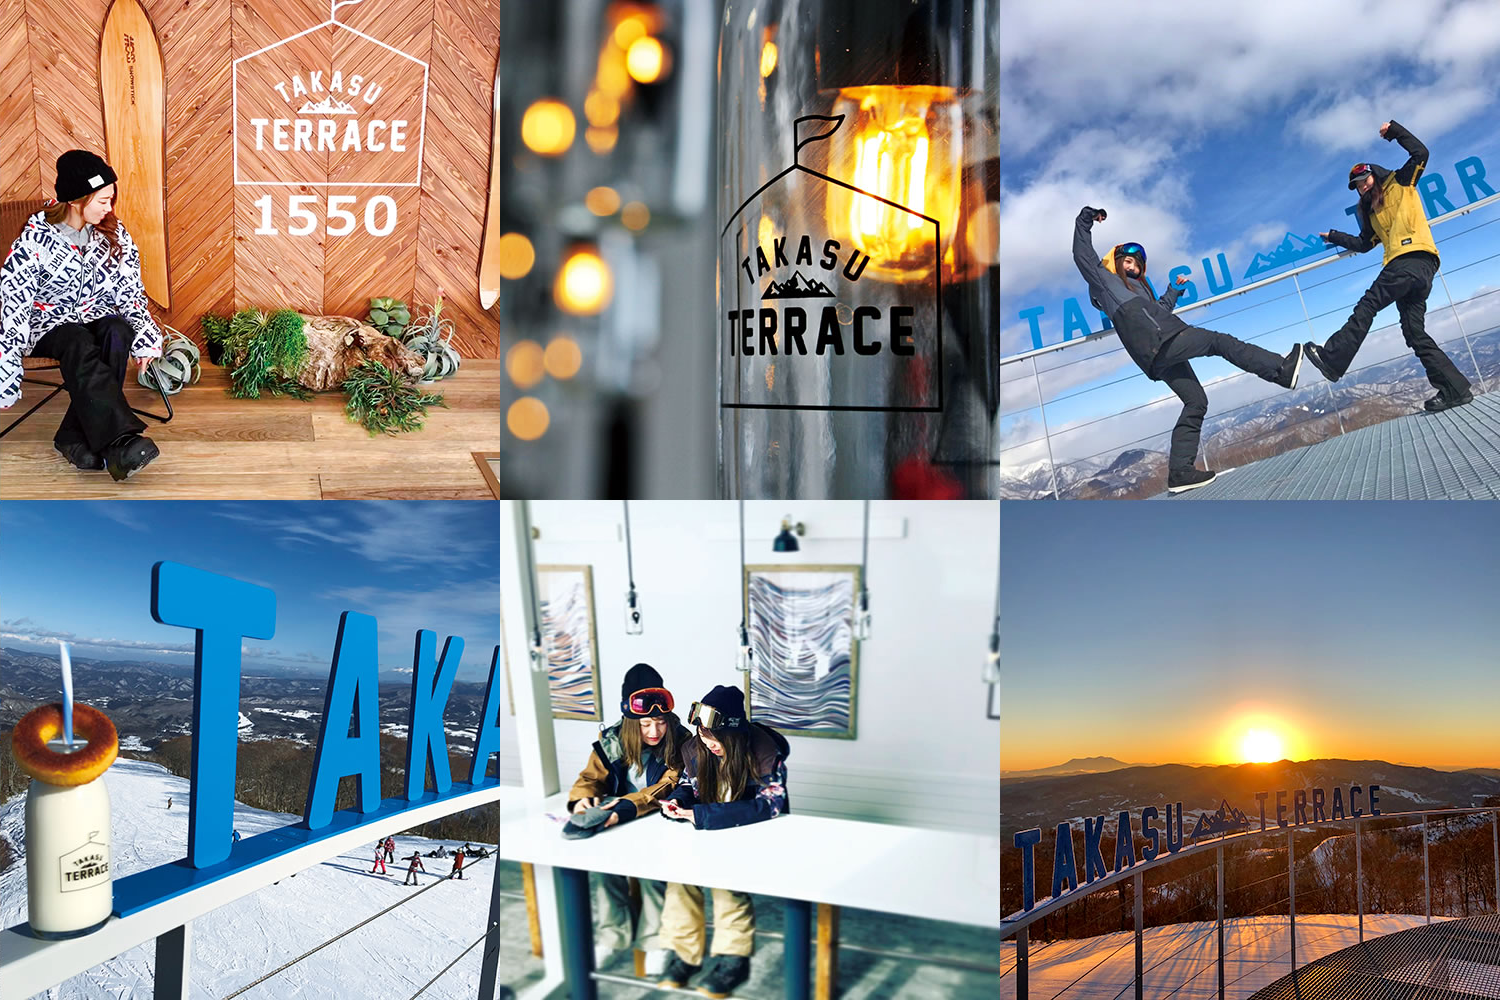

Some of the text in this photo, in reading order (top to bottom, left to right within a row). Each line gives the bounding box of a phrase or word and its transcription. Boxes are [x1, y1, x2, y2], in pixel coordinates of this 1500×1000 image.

[274, 70, 382, 105] TAKASU
[250, 118, 409, 152] TERRACE
[254, 194, 398, 237] 1550
[742, 235, 870, 284] TAKASU
[1018, 252, 1234, 350] TASU
[728, 306, 915, 357] TERRACE
[1013, 784, 1382, 913] TAKASU TERRACE
[64, 862, 109, 882] TERRACE
